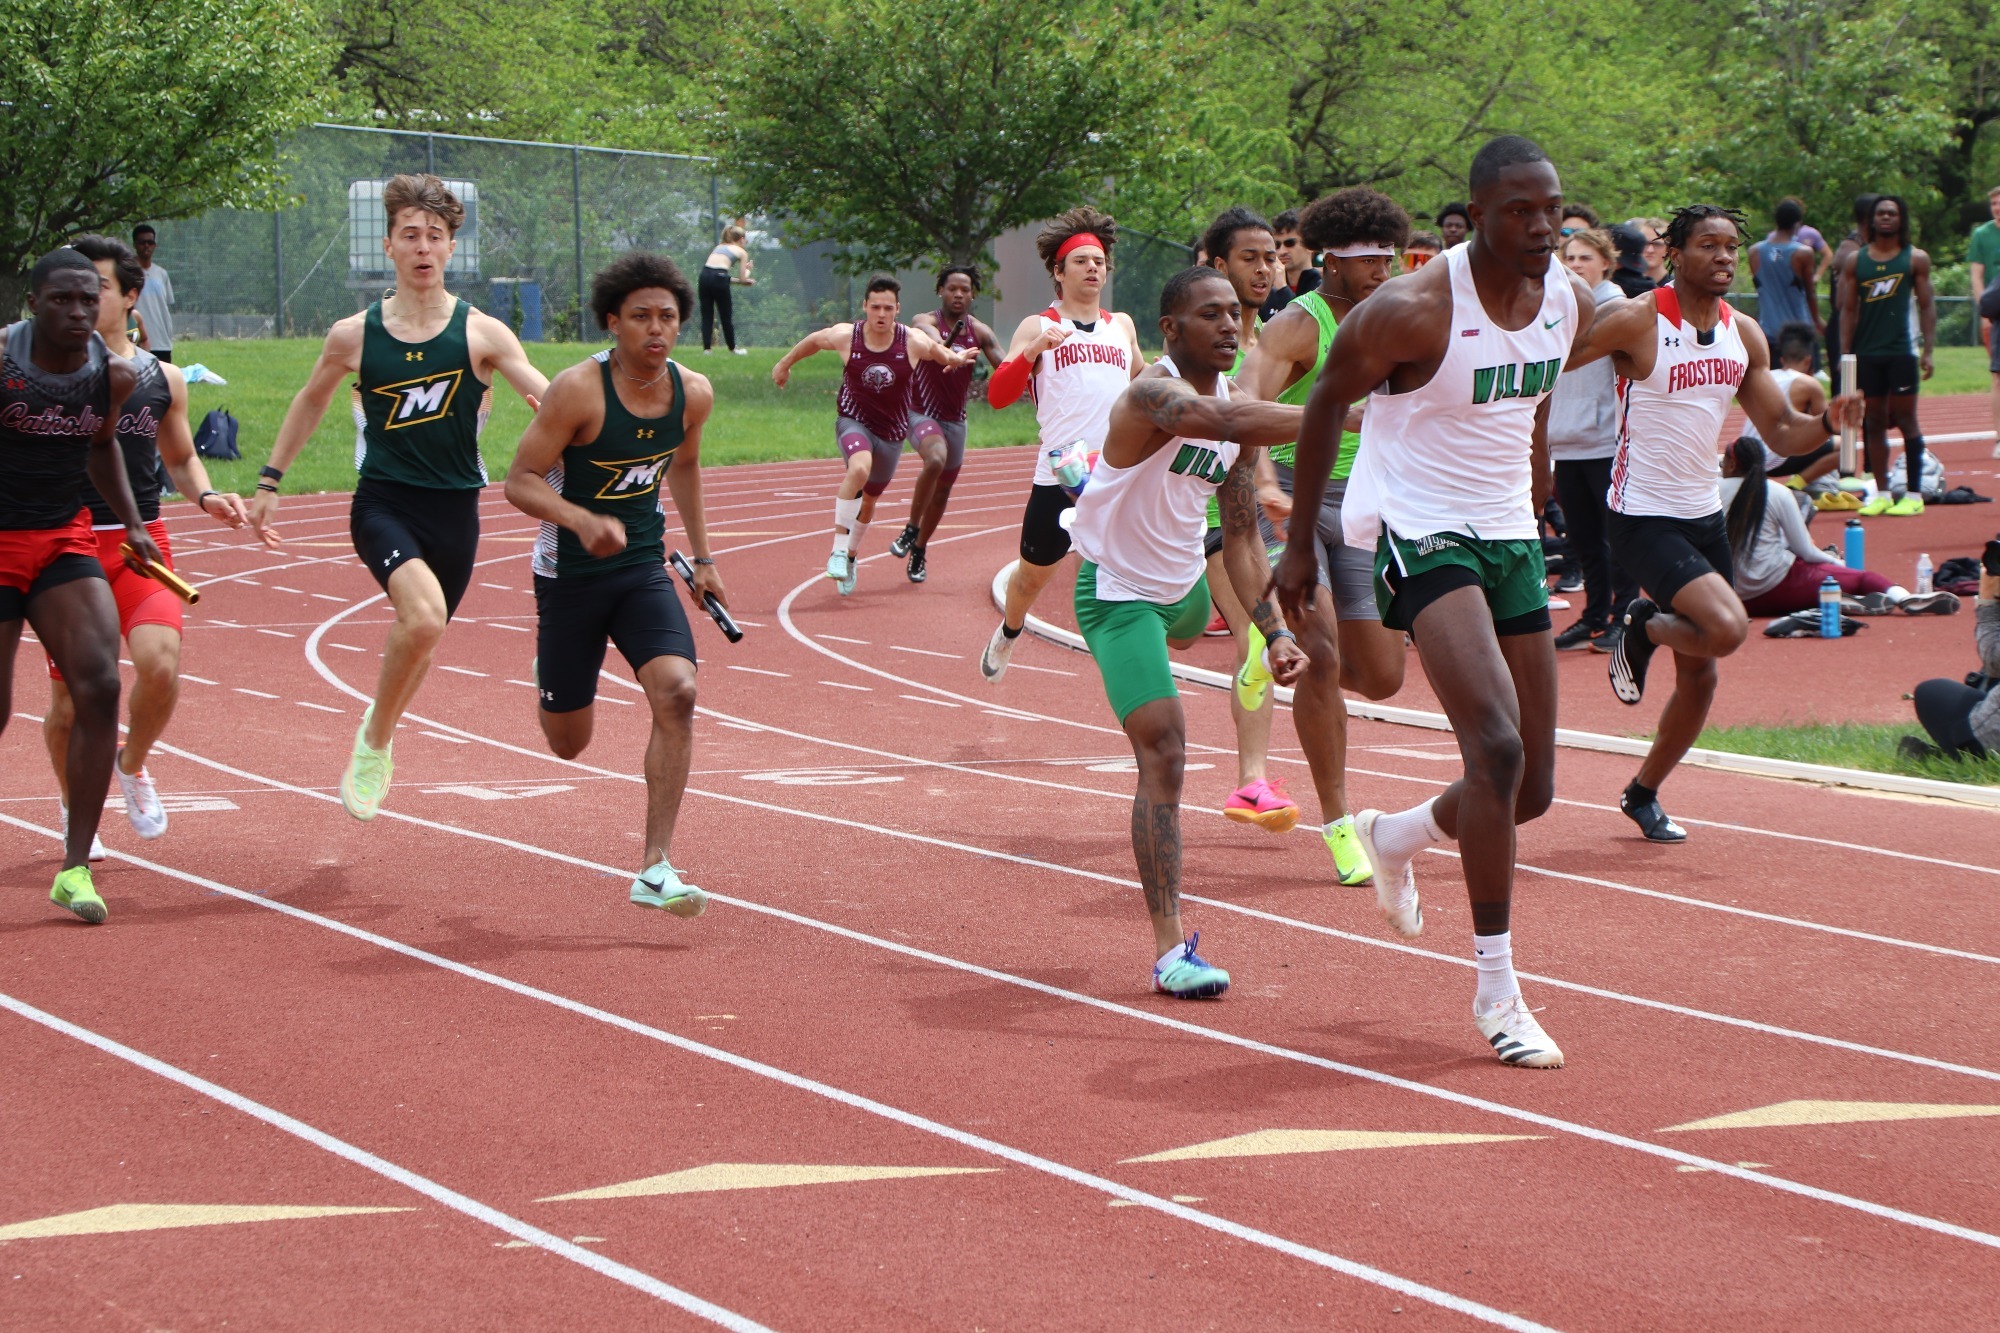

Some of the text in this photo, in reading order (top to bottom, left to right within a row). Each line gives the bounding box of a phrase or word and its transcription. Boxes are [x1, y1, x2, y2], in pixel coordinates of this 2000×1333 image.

[1053, 342, 1127, 372] FROSTBURG
[399, 379, 452, 419] M
[1472, 357, 1561, 404] WILMU
[614, 456, 670, 491] M
